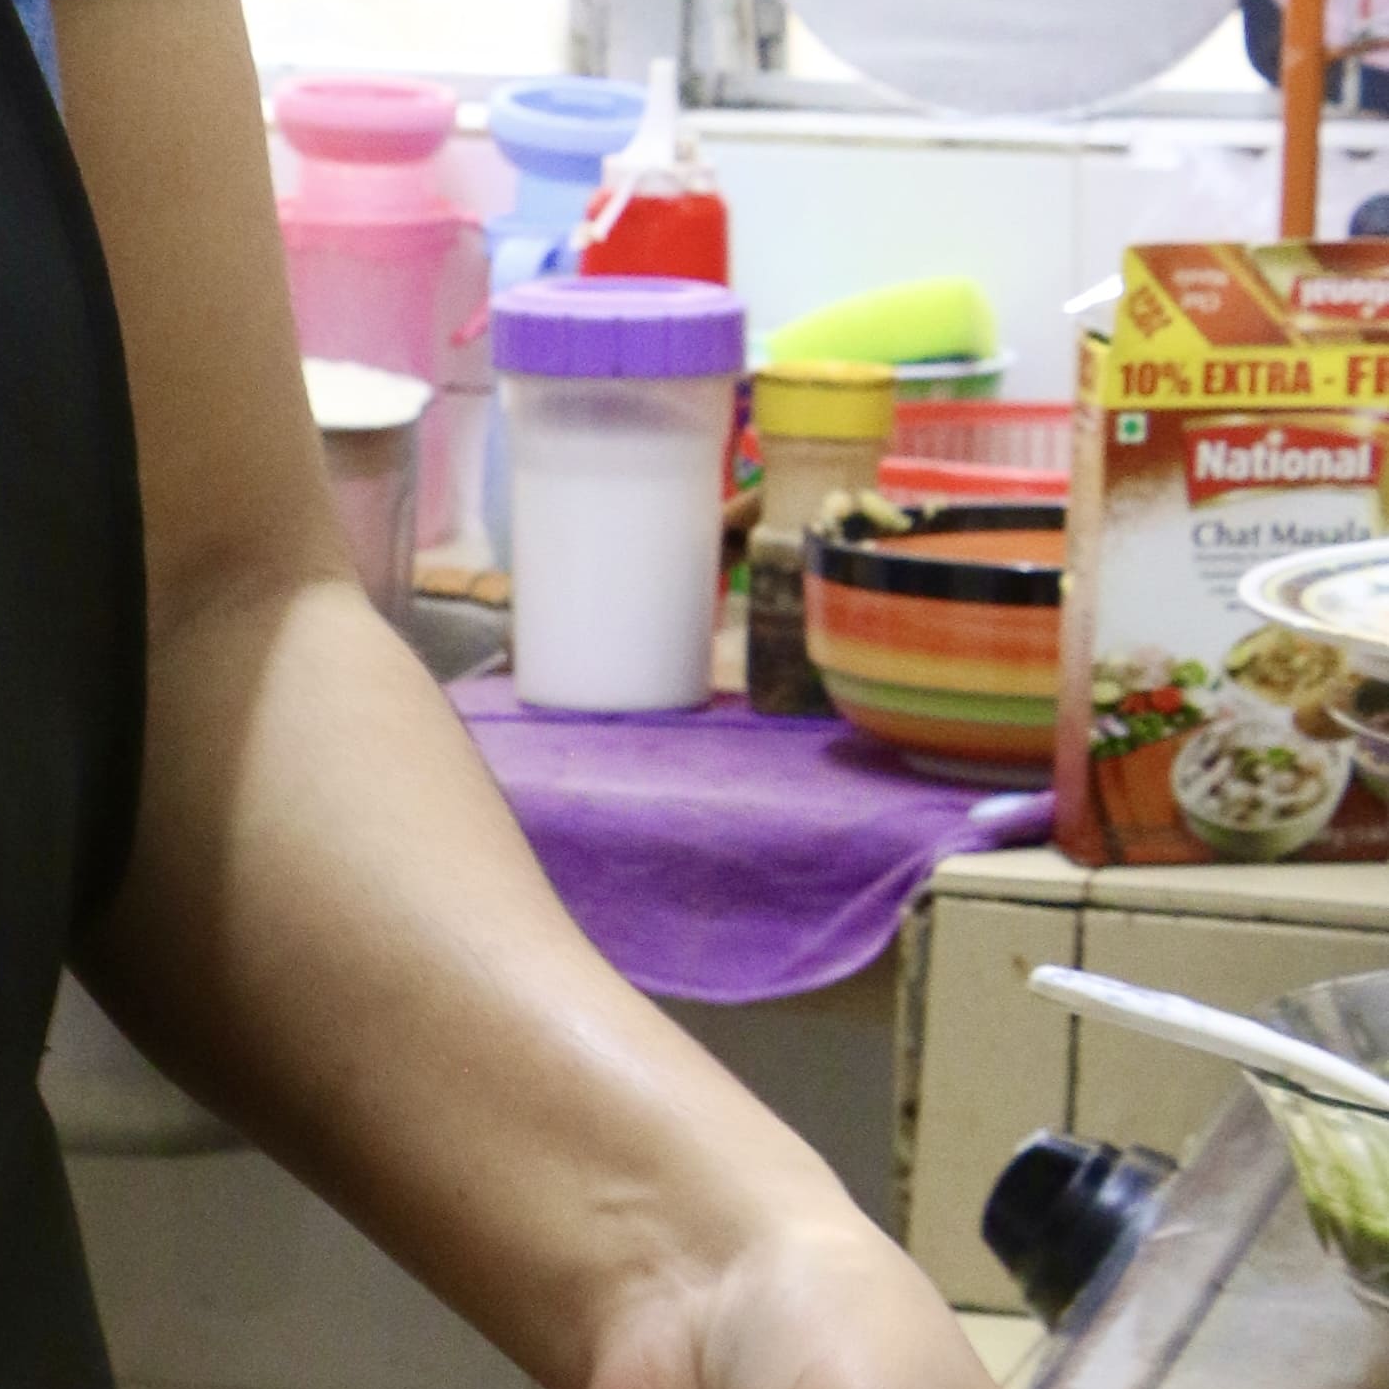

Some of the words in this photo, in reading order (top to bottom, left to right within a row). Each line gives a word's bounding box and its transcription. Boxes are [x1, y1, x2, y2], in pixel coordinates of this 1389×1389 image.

[1120, 362, 1191, 396] 10%
[1202, 361, 1312, 396] EXTRA
[1194, 429, 1372, 481] National
[1191, 521, 1260, 547] Chat
[1270, 518, 1371, 545] Masala
